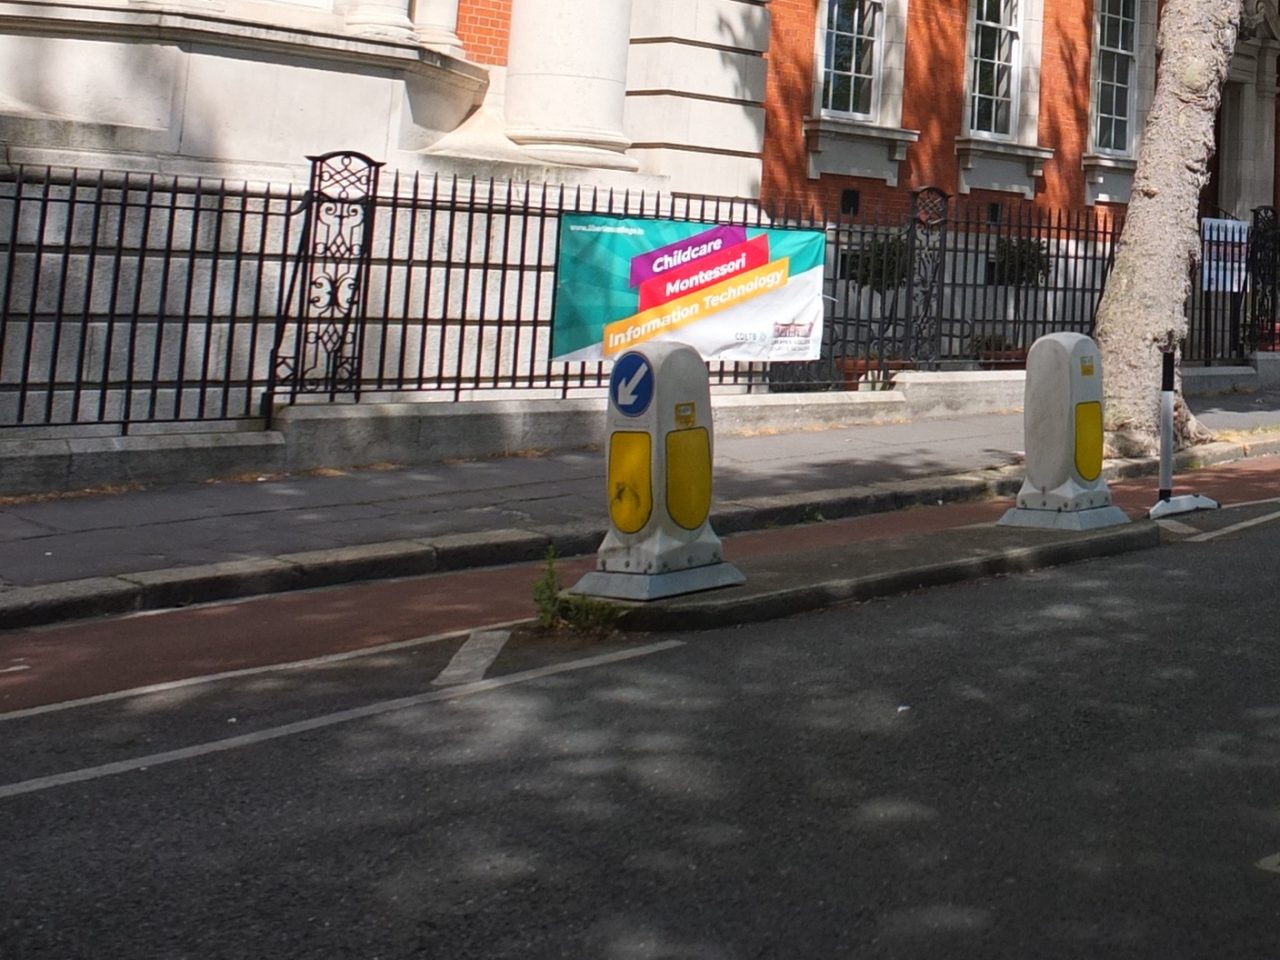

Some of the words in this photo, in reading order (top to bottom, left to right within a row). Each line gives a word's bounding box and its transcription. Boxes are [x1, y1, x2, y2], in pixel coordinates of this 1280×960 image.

[652, 238, 723, 273] Childcare
[665, 252, 747, 297] Montessori
[609, 302, 700, 348] Information
[704, 269, 784, 309] Technology
